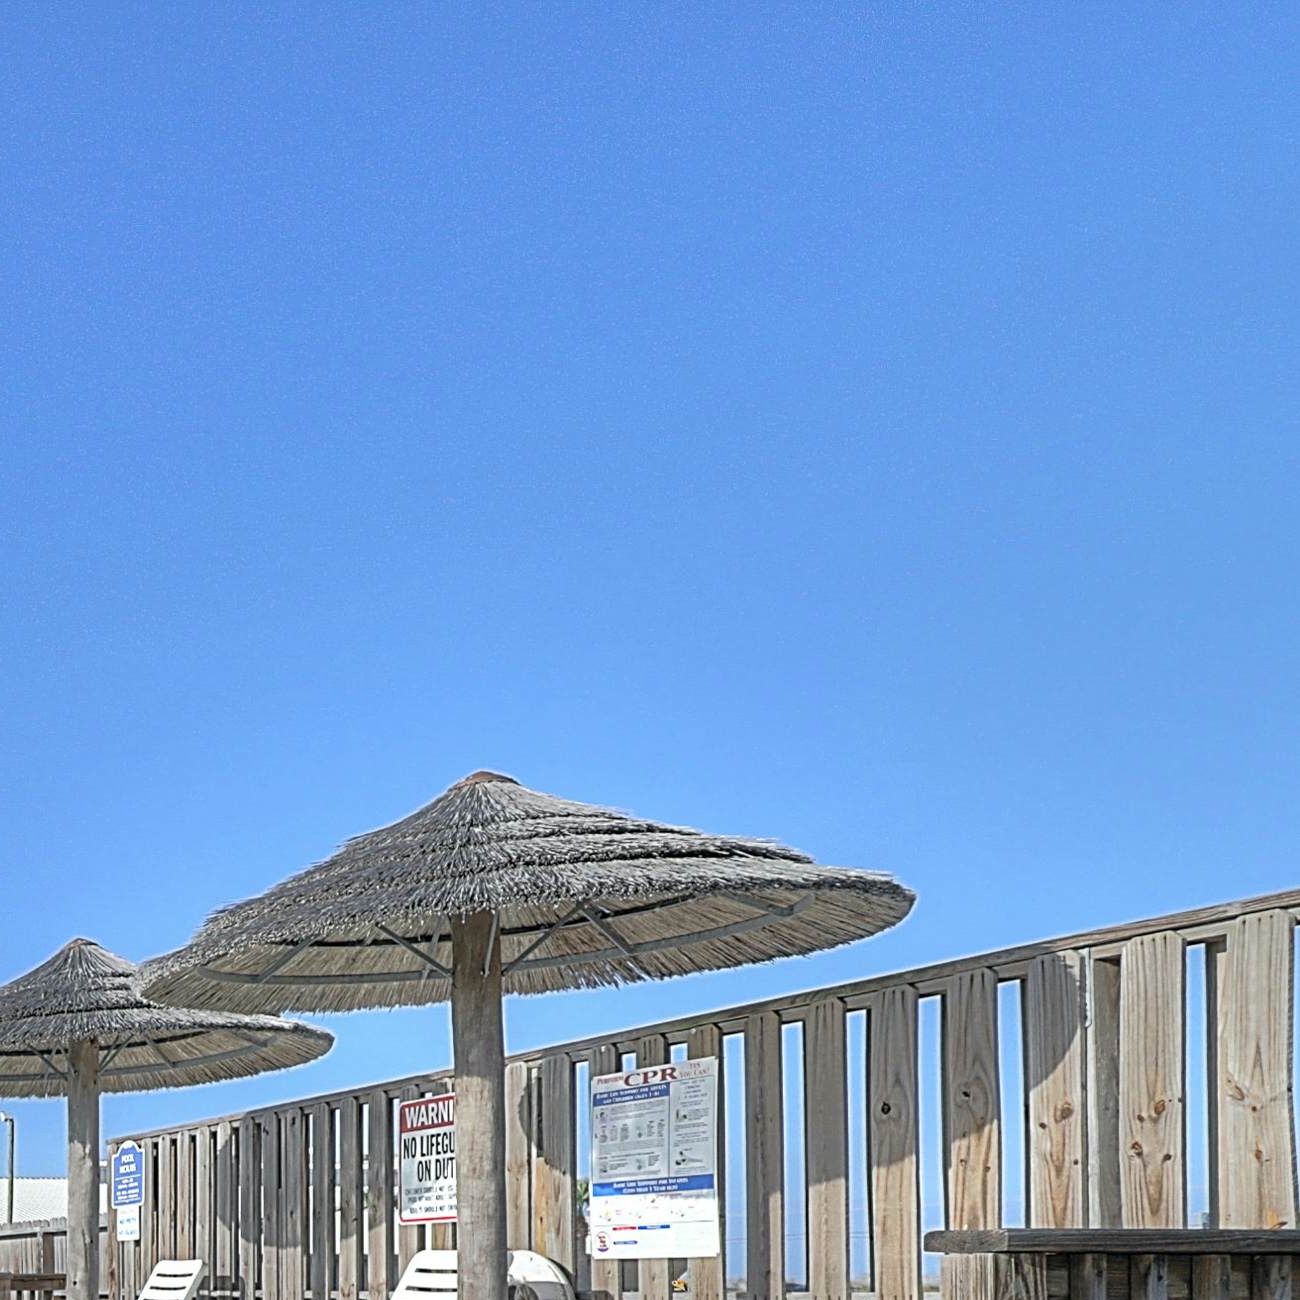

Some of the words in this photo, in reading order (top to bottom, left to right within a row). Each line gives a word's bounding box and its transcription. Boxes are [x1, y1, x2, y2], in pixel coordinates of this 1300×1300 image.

[624, 1067, 677, 1087] CPR
[405, 1099, 454, 1129] WARNI
[403, 1137, 417, 1160] NO
[420, 1132, 455, 1157] LIFEGU
[417, 1160, 431, 1182] ON
[435, 1157, 456, 1180] DUT
